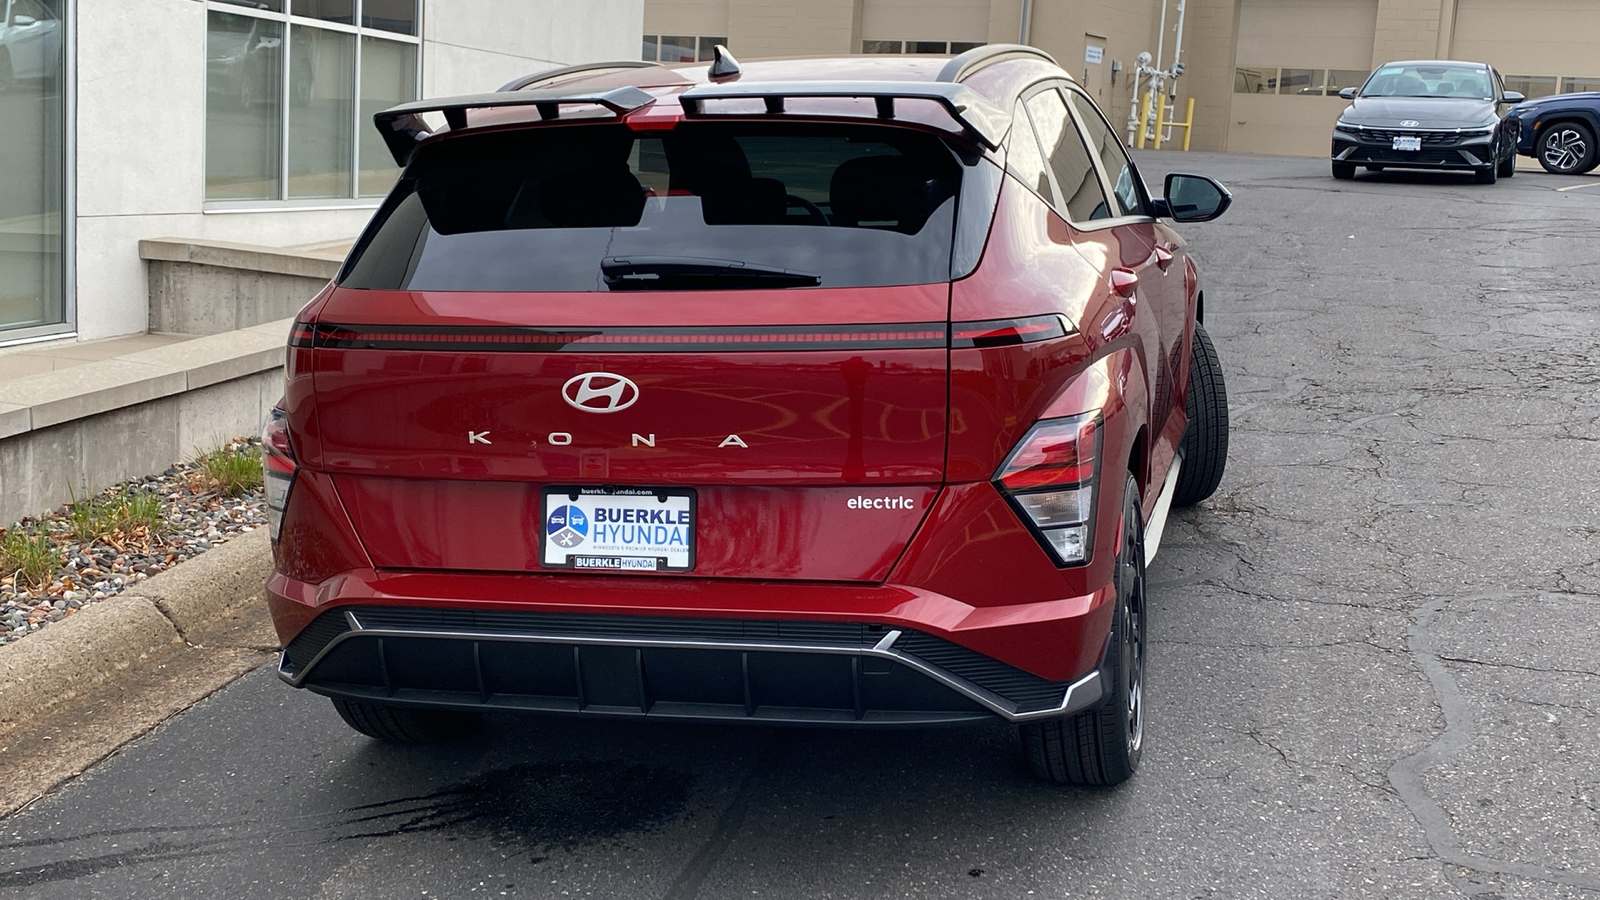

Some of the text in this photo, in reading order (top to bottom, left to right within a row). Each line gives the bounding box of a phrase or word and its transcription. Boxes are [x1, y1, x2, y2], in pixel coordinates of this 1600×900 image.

[468, 431, 748, 448] KONA
[847, 495, 914, 509] electric
[594, 508, 690, 524] BUERKLE
[593, 524, 690, 545] HYUNDAI
[576, 557, 655, 569] BUERKLE HYUNDAI
